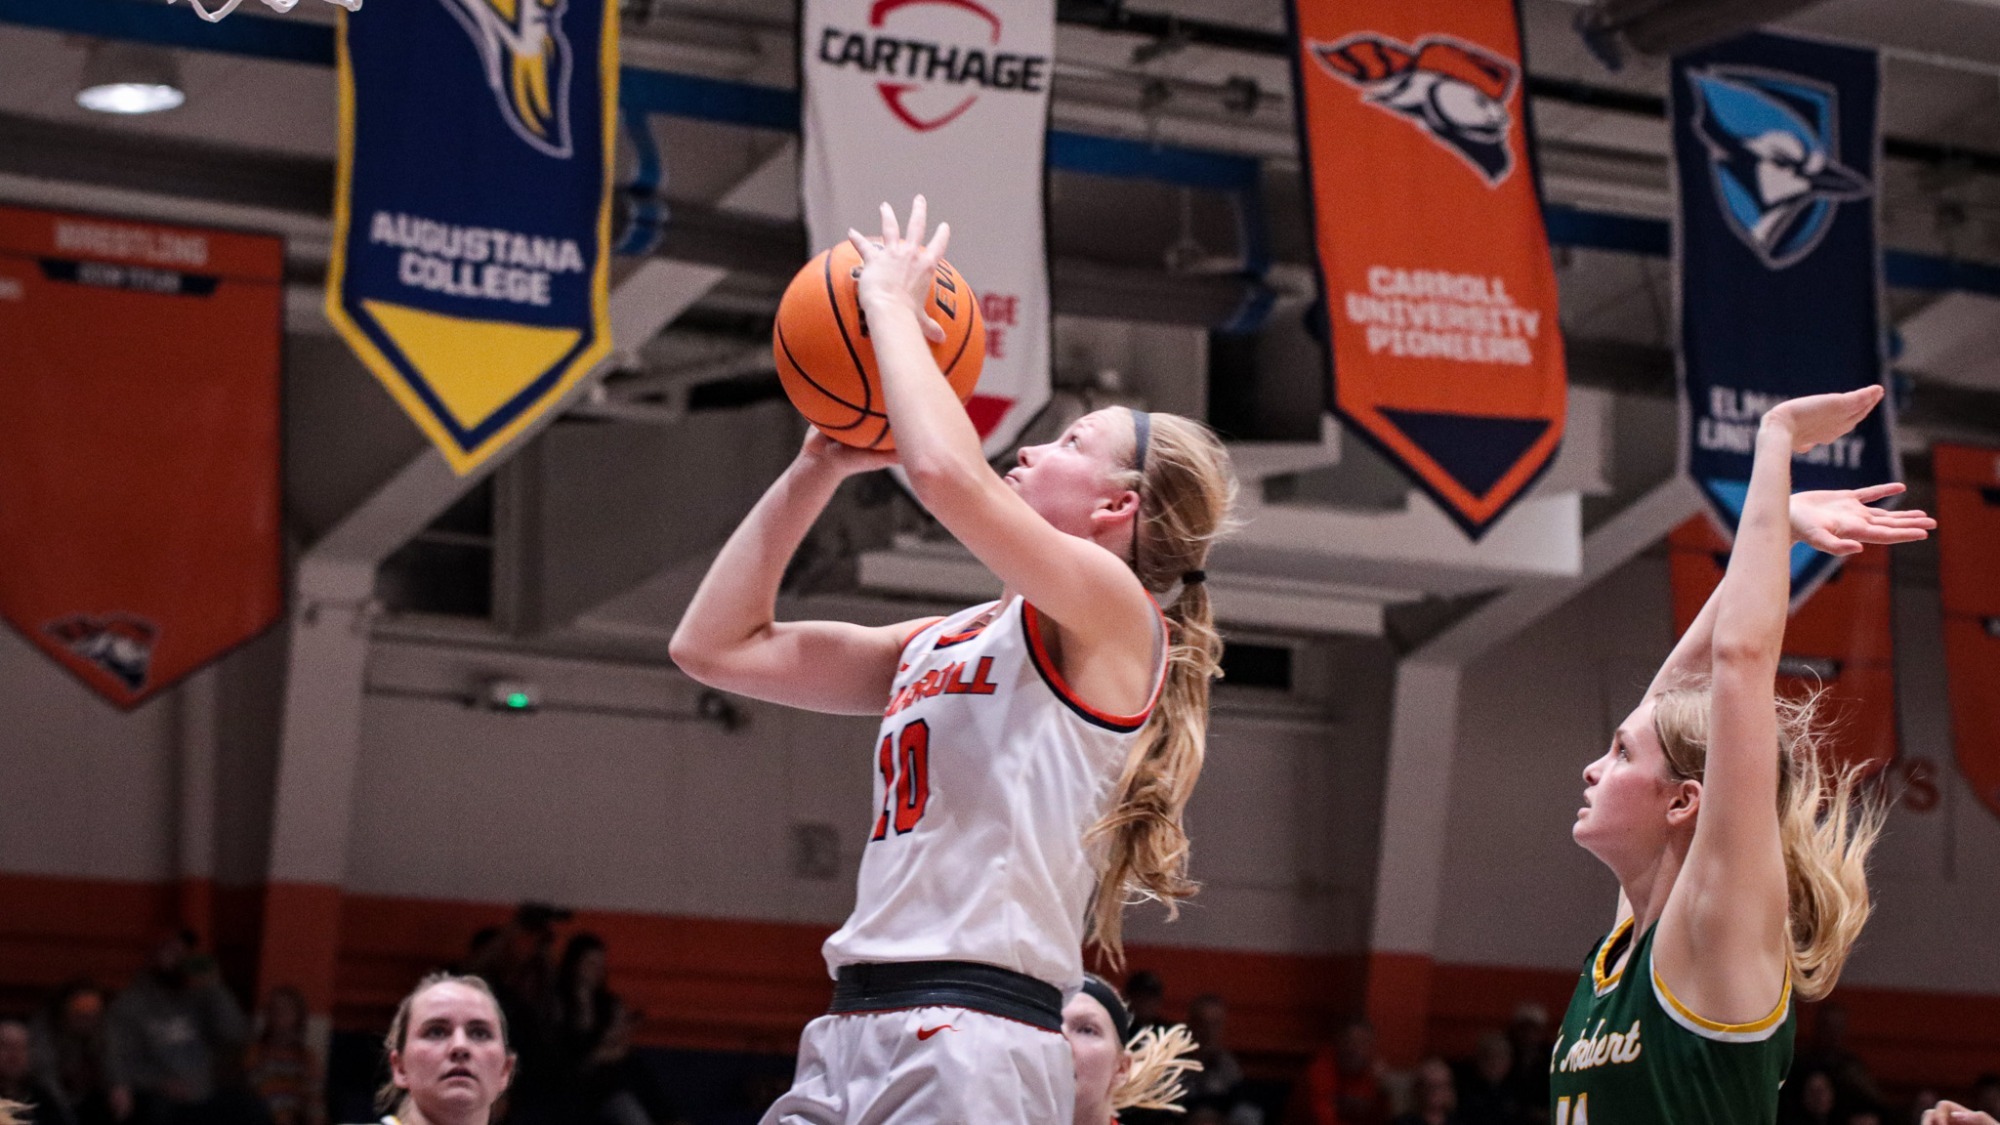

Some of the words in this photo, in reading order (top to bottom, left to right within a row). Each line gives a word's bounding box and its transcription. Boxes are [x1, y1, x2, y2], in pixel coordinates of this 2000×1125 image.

[819, 28, 1048, 91] CARTHAGE
[370, 211, 585, 273] AUGUSTANA
[399, 252, 551, 307] COLLEGE
[1367, 265, 1514, 306] CARROLL
[1345, 291, 1540, 340] UNIVERSITY
[1366, 326, 1533, 366] PIONEERS
[882, 656, 998, 720] ARROLL
[872, 717, 930, 842] 10
